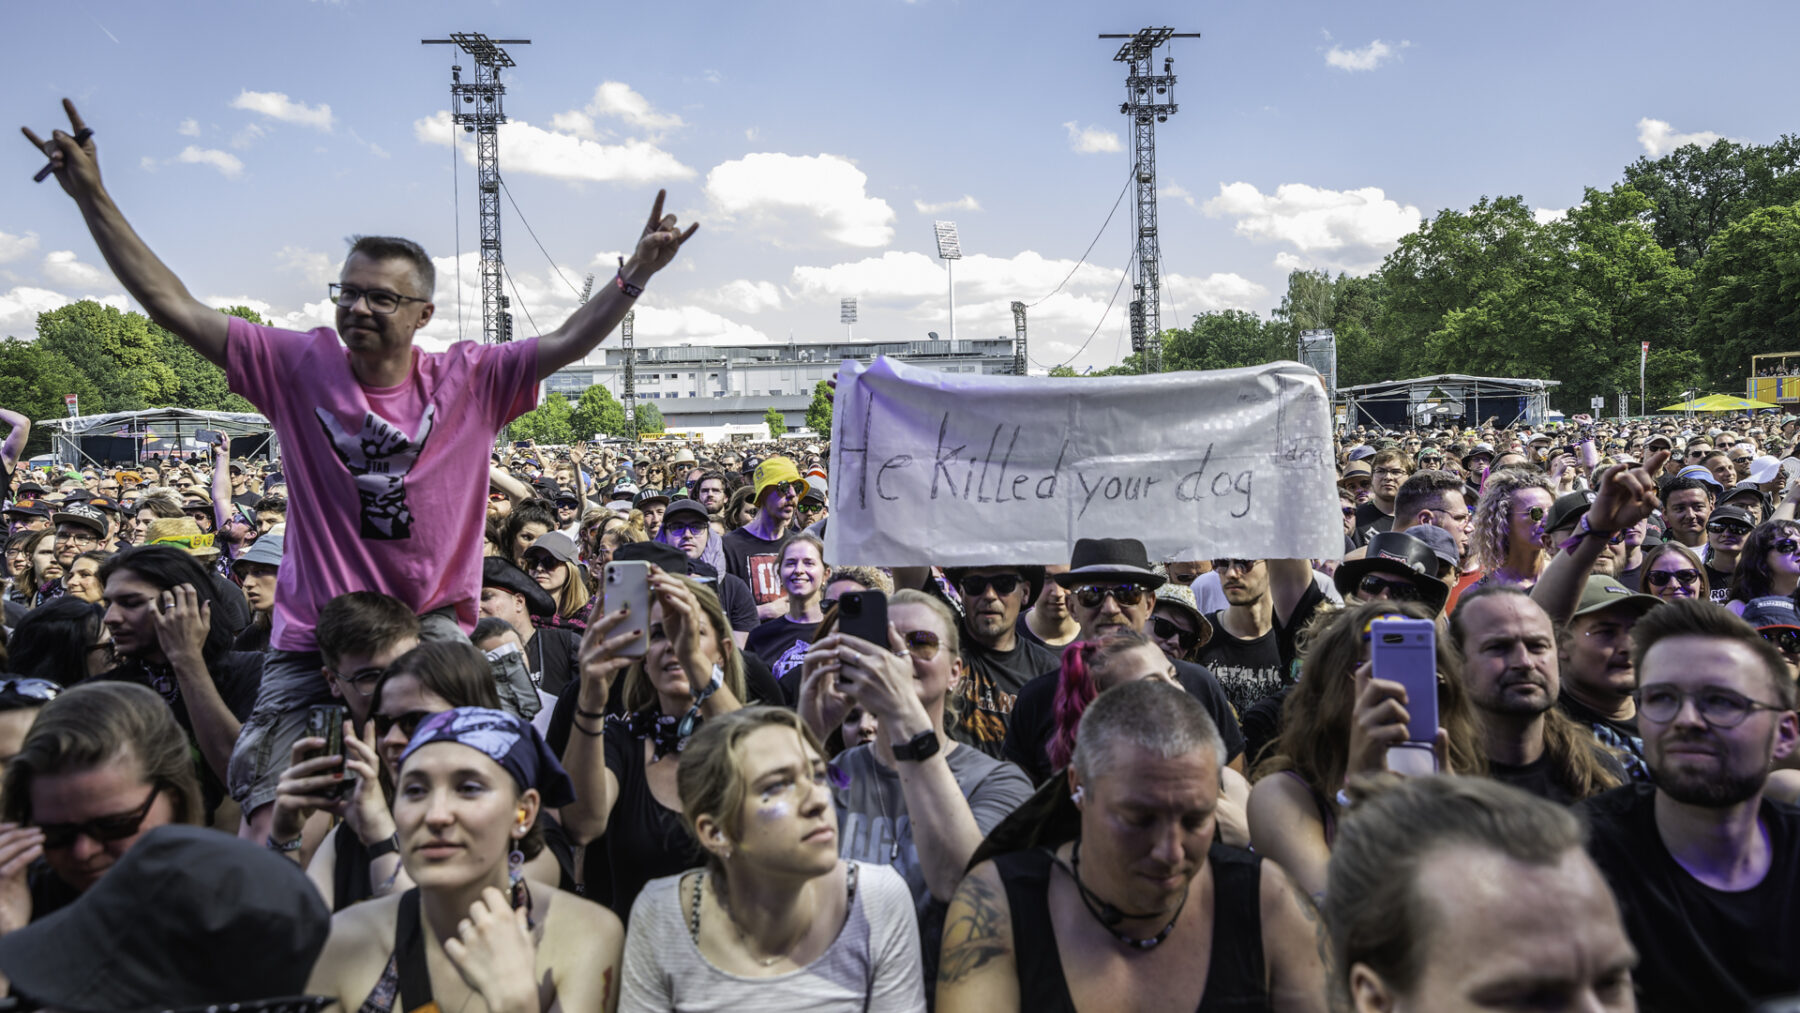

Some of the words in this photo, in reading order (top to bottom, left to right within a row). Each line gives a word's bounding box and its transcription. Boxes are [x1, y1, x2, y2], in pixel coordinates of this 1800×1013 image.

[365, 460, 390, 474] STAR
[833, 391, 913, 512] He
[1077, 472, 1161, 521] your
[1175, 442, 1254, 519] dog
